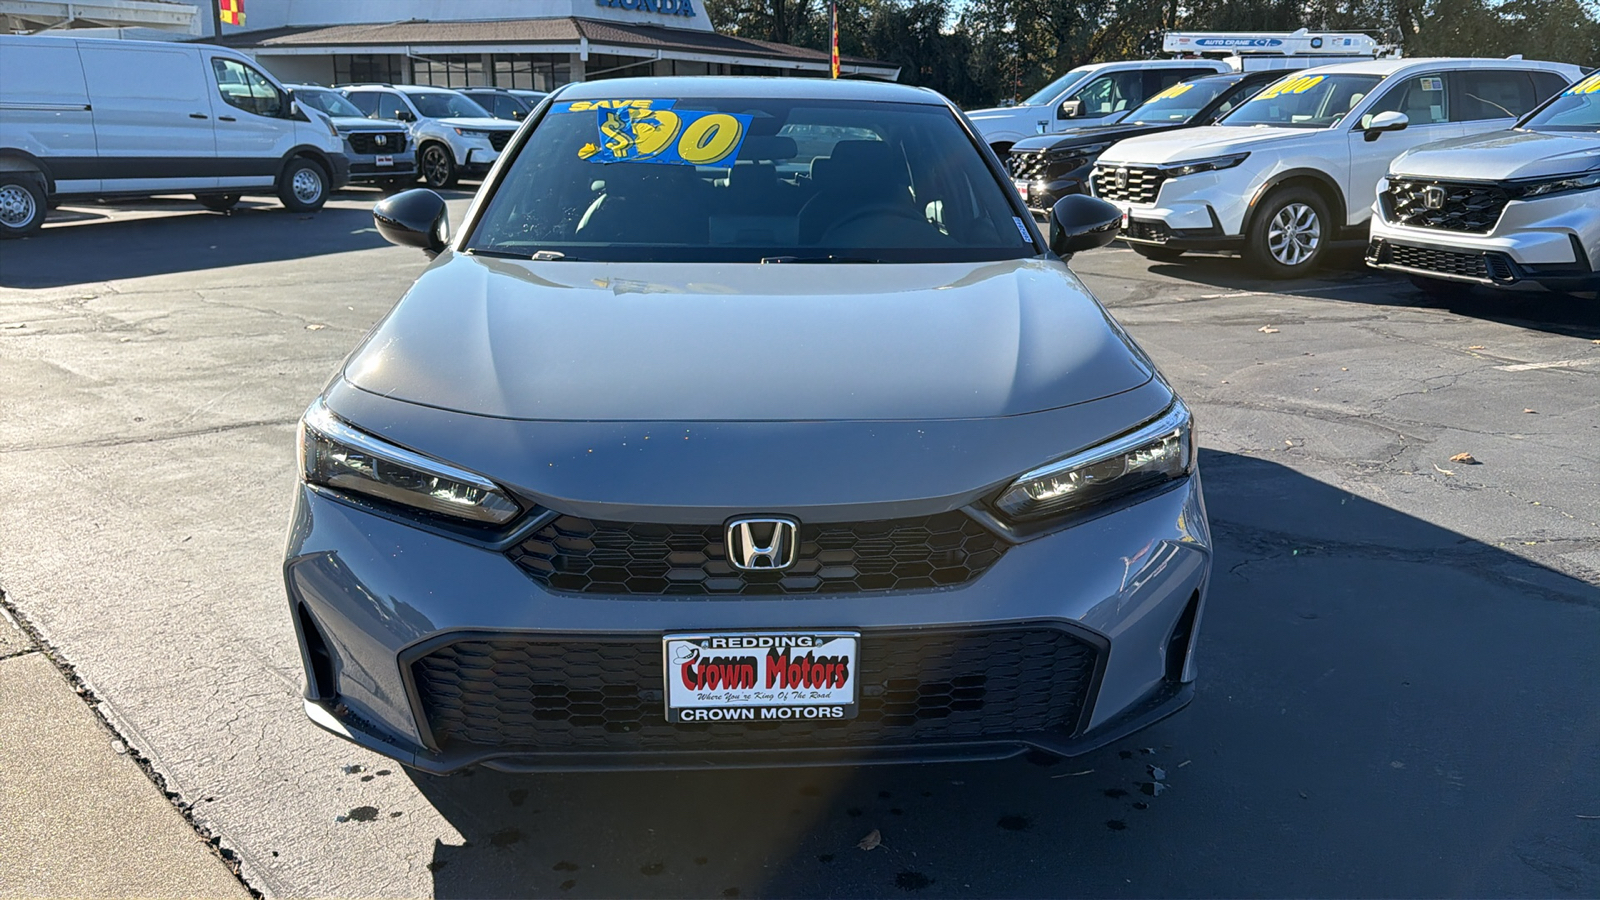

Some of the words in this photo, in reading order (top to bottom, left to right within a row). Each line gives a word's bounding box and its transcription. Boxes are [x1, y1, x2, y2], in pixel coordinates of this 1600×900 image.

[569, 99, 653, 113] SAVE
[712, 636, 813, 649] REDDING
[681, 652, 758, 691] Crown
[766, 650, 849, 690] Motors
[697, 692, 722, 701] Where
[724, 691, 751, 703] You're
[754, 691, 774, 701] King
[777, 691, 789, 702] Of
[791, 691, 806, 700] The
[809, 691, 832, 700] Road
[680, 708, 754, 721] CROWN
[760, 706, 844, 720] MOTORS
